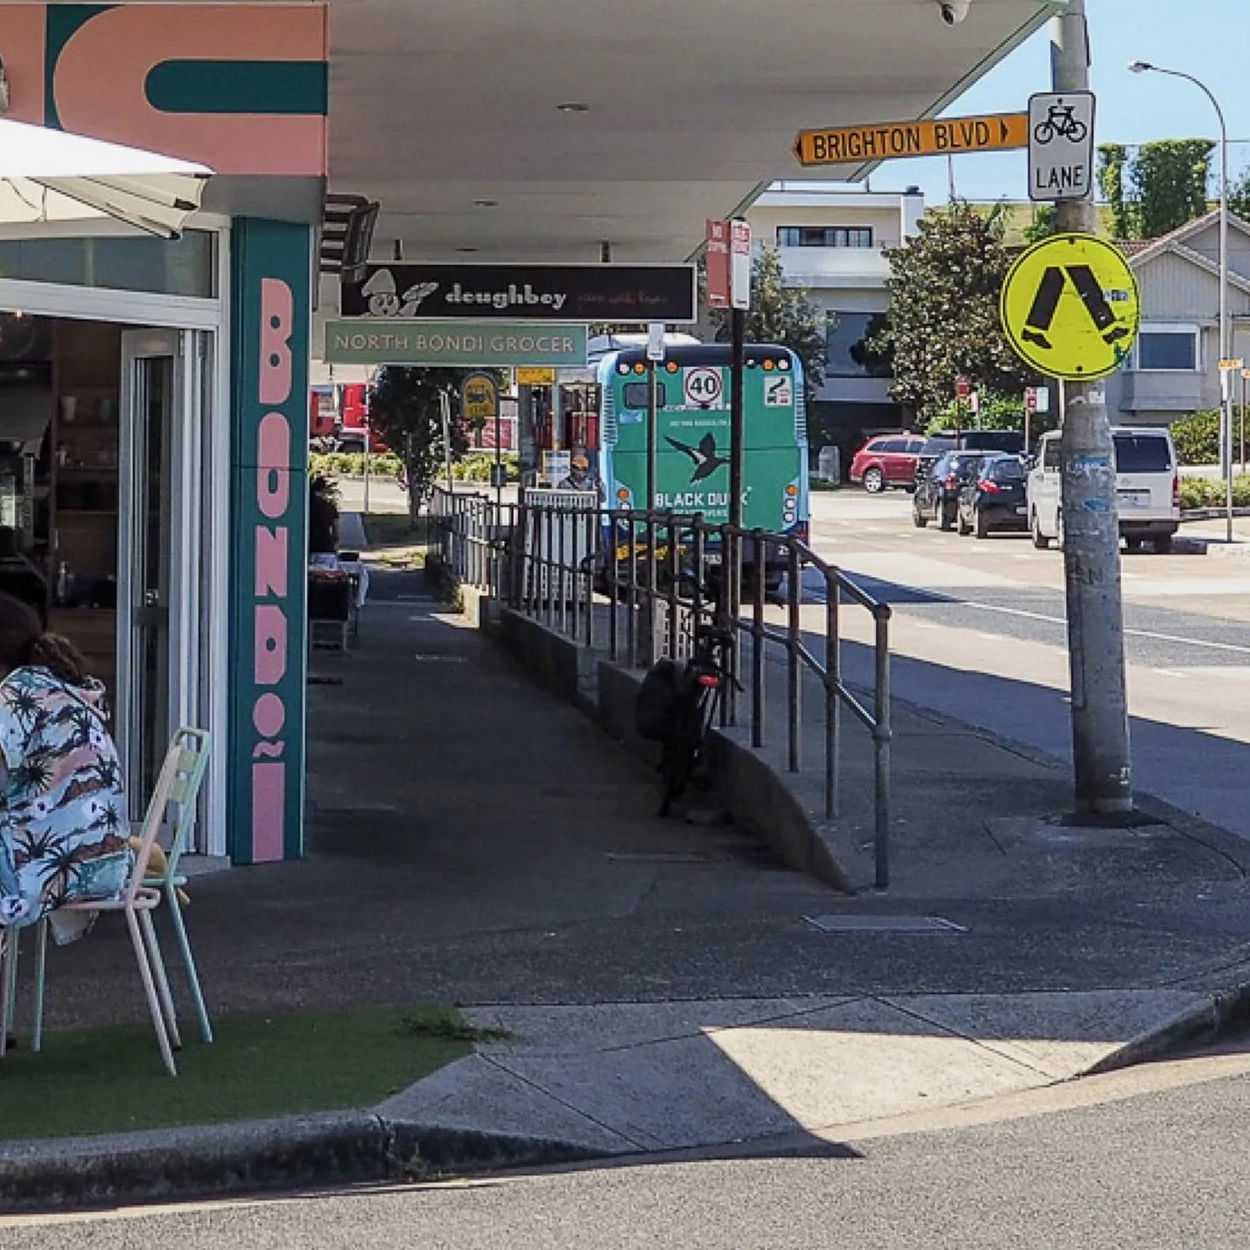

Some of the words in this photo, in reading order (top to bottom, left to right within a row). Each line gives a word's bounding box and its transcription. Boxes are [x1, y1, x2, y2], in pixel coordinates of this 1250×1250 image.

[813, 126, 921, 159] BRIGHTON
[935, 121, 990, 149] BLVD
[1036, 165, 1084, 189] LANE
[445, 283, 567, 310] doughboy
[335, 334, 408, 351] NORTH
[417, 335, 483, 352] BONDI
[488, 335, 574, 353] GROCER
[690, 377, 716, 395] 40
[655, 492, 704, 507] BLACK
[707, 492, 748, 506] DUK
[252, 278, 292, 862] BONDI
